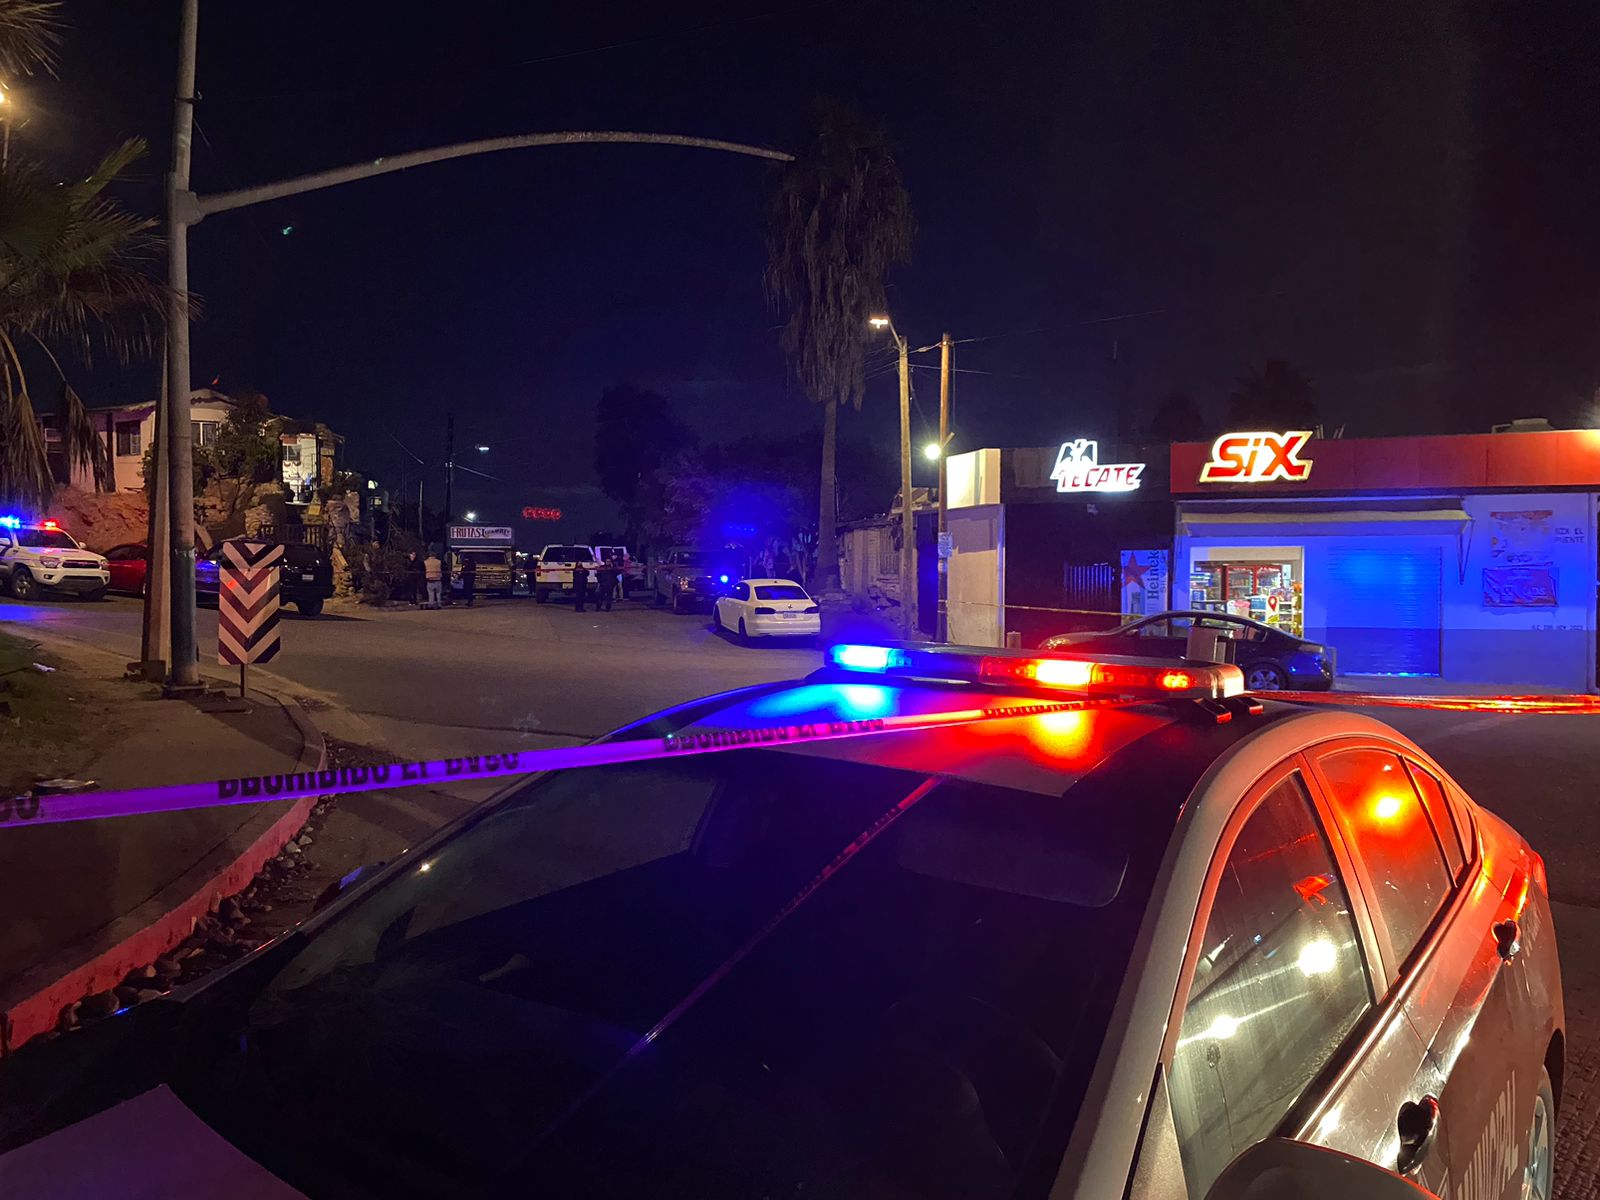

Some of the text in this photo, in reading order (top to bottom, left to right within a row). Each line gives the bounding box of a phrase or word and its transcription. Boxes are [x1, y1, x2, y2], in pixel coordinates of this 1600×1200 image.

[1057, 465, 1140, 488] TECATE
[451, 527, 481, 538] FRUTAS
[1147, 551, 1160, 600] Heinek
